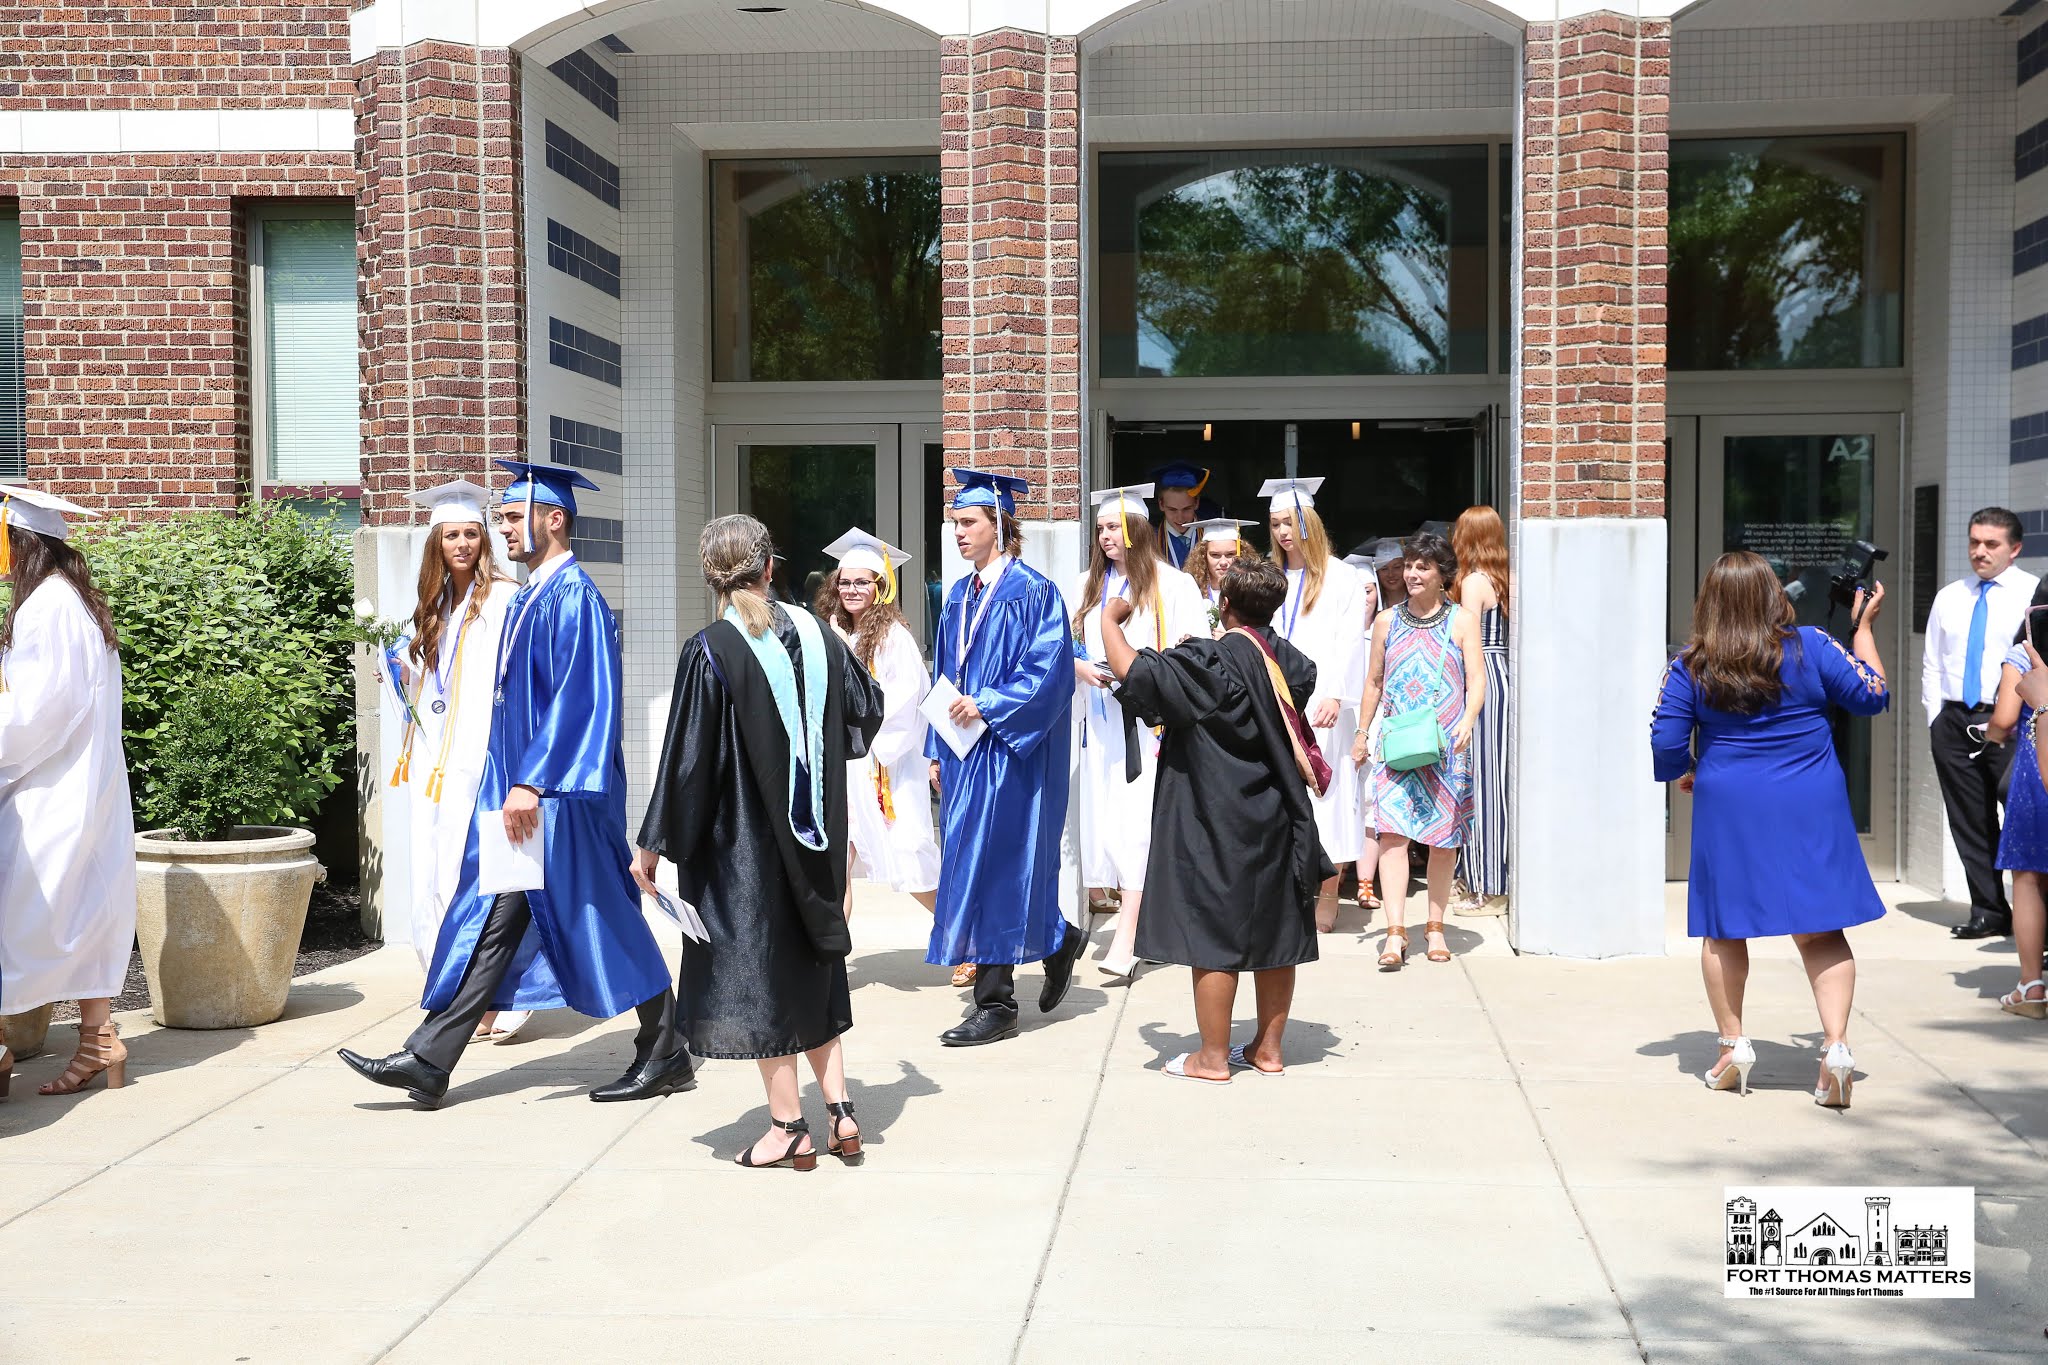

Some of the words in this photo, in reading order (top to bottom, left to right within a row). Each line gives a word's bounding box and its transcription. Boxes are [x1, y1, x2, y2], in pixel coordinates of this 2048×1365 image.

[1828, 437, 1870, 461] A2
[1774, 530, 1794, 538] during
[1828, 530, 1840, 538] day
